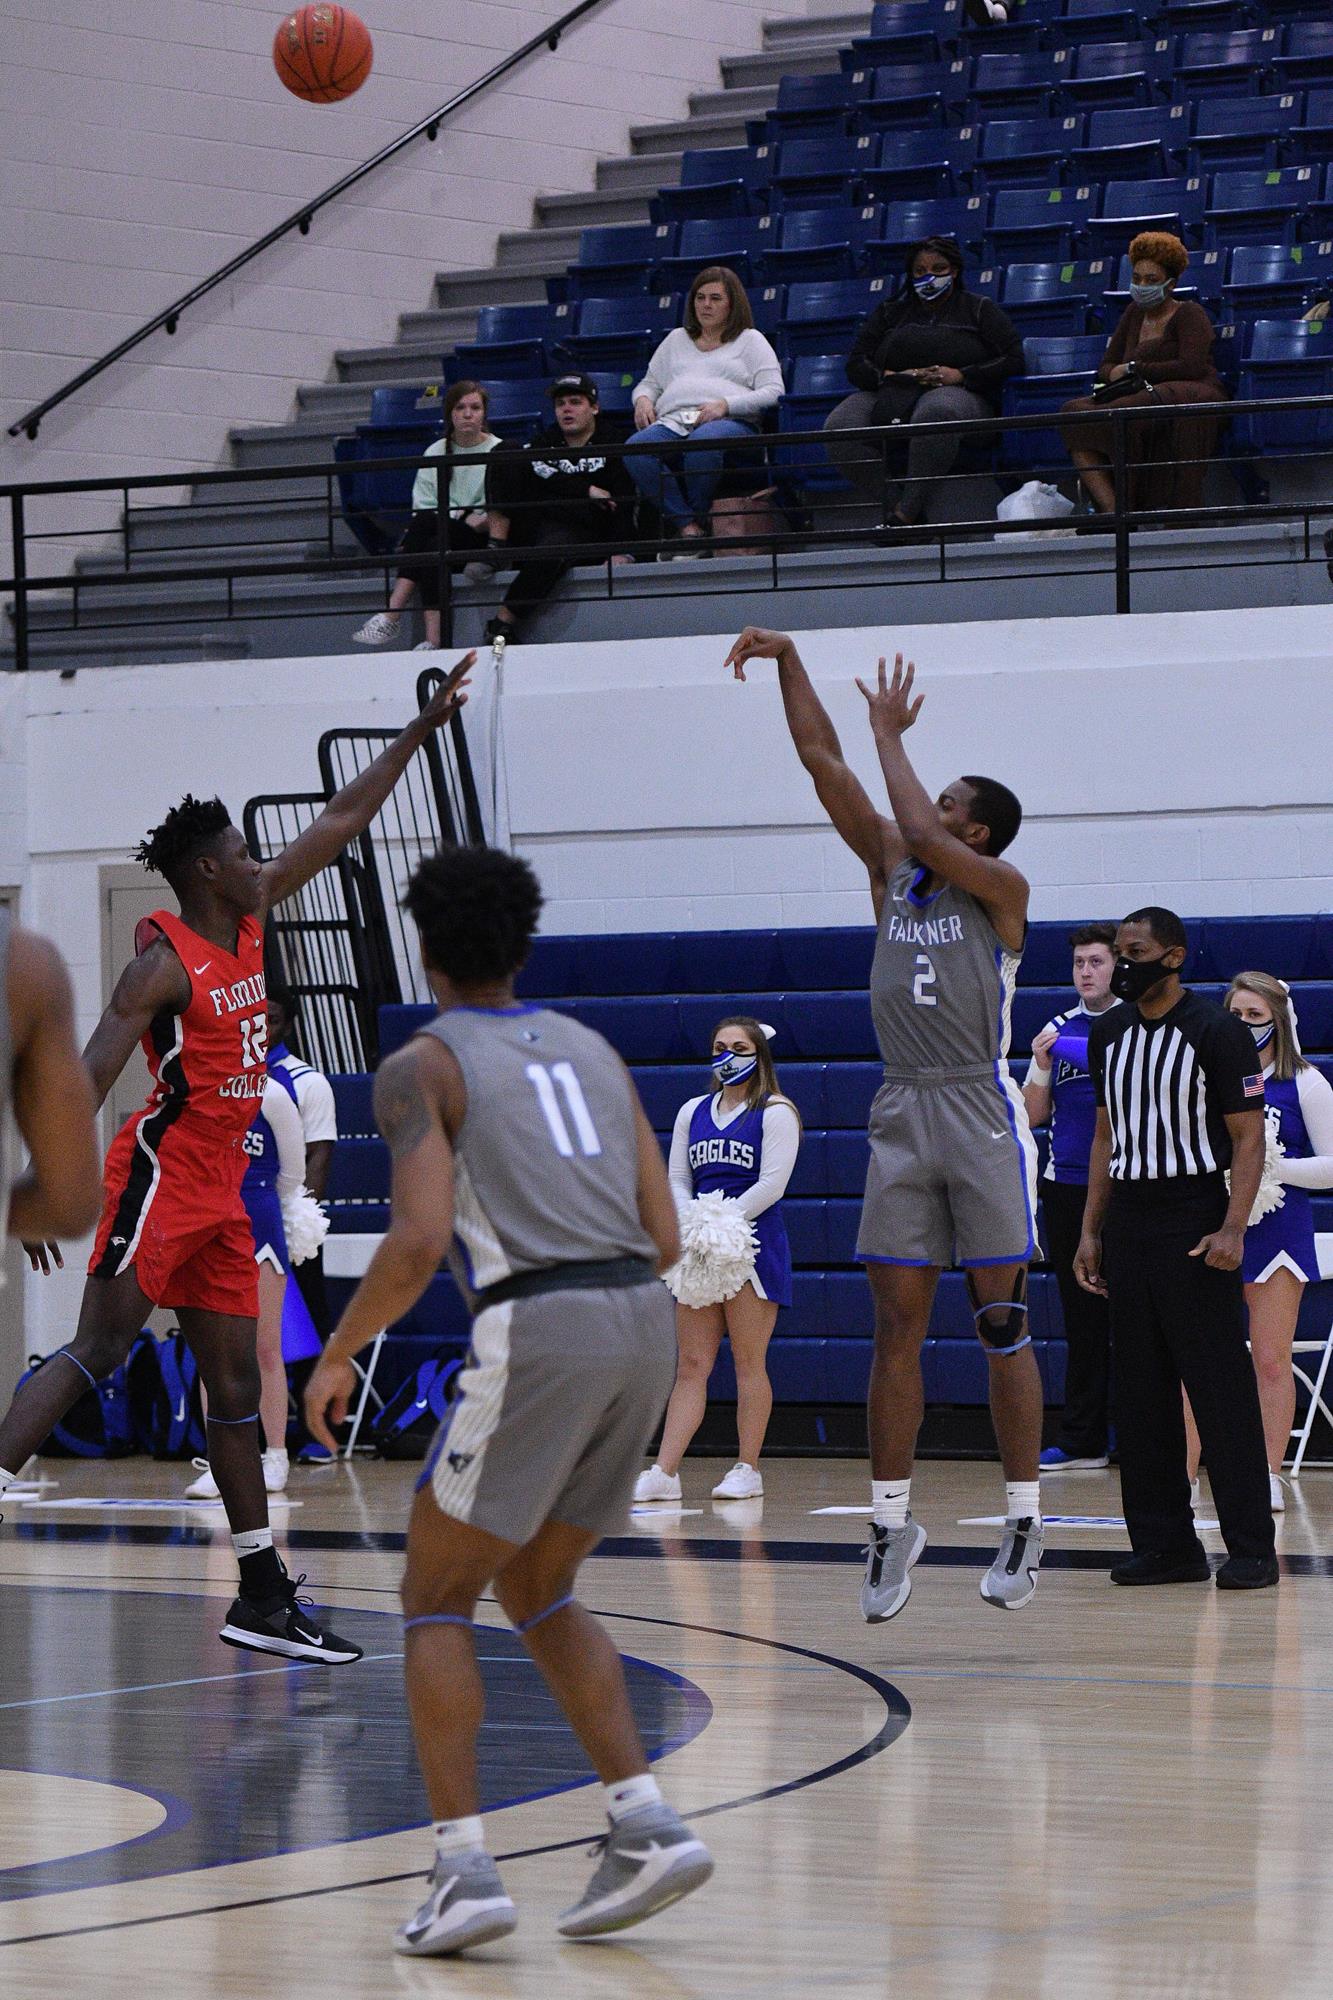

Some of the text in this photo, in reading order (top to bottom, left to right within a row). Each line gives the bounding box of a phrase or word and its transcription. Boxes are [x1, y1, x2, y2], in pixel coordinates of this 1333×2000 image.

[209, 971, 266, 1016] FLORID
[913, 953, 937, 1006] 2
[240, 1012, 268, 1069] 12
[526, 1062, 602, 1157] 11
[689, 1139, 754, 1169] EAGLES
